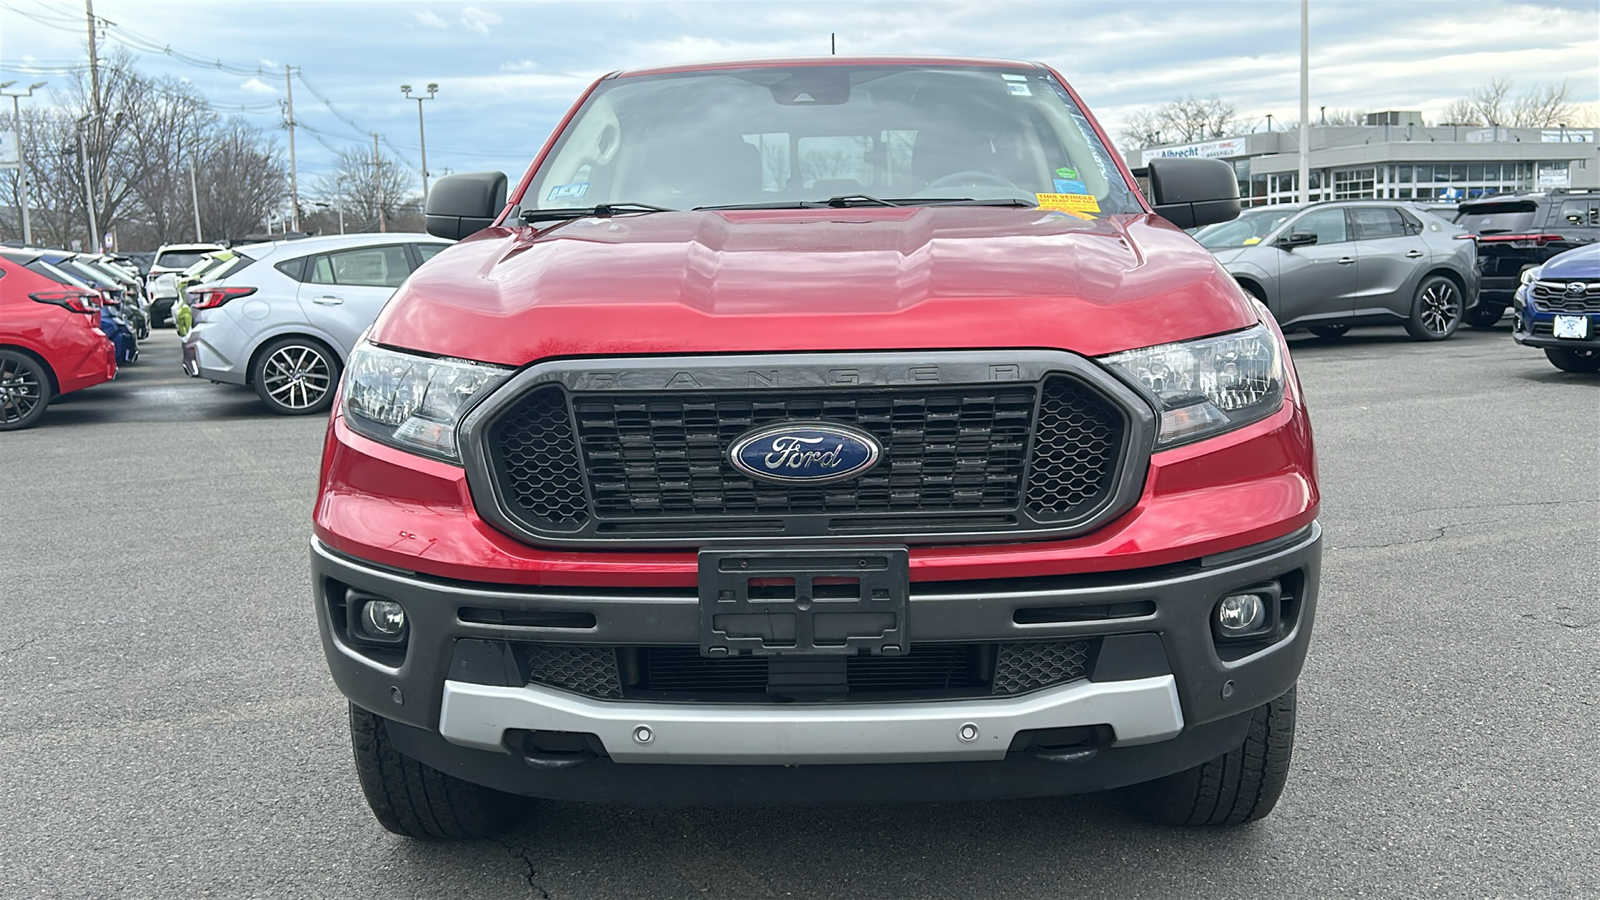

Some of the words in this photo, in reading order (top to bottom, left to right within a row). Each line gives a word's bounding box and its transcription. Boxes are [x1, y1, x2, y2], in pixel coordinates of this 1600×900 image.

[1161, 147, 1198, 158] Albrecht
[588, 364, 1020, 388] RANGER
[764, 436, 843, 468] Ford
